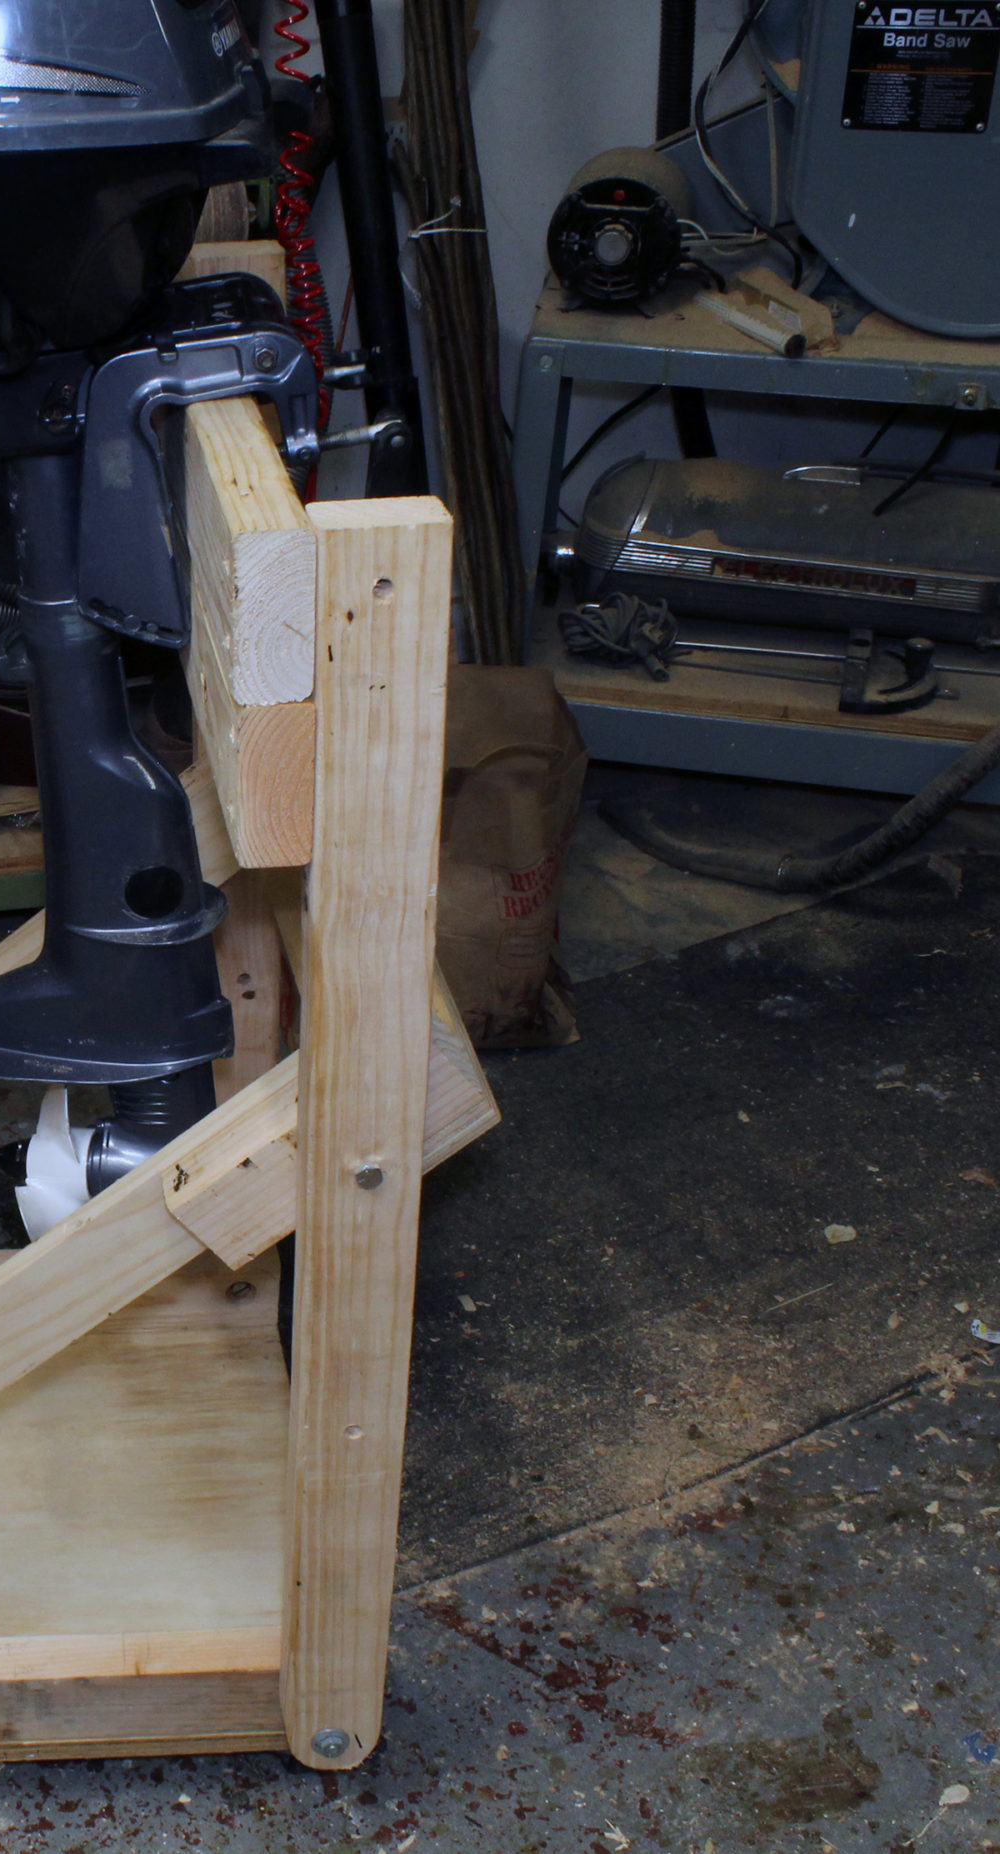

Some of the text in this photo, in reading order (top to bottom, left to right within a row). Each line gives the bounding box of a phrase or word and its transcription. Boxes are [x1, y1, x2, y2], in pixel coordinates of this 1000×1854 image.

[889, 8, 993, 27] DELTA
[883, 32, 971, 48] Band Saw
